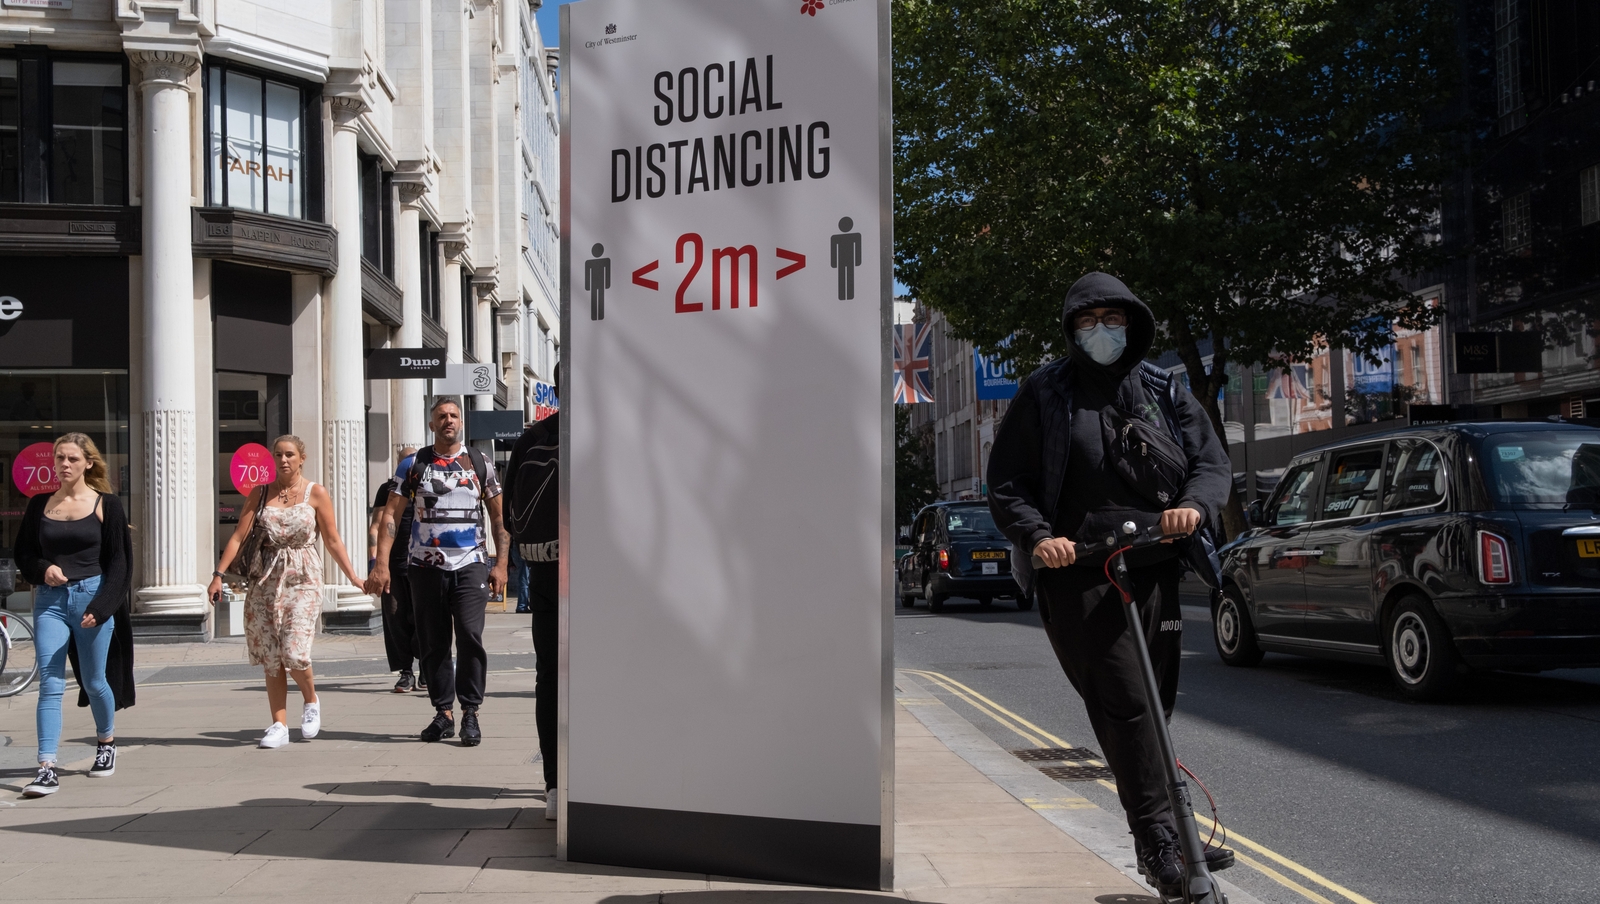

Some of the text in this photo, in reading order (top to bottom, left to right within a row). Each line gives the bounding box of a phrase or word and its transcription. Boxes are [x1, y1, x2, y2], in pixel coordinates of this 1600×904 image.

[585, 41, 596, 49] City
[604, 34, 637, 44] Westminster
[653, 54, 783, 126] SOCIAL
[219, 154, 294, 184] FARAH
[611, 120, 831, 204] DISTANCING
[241, 227, 280, 242] MAPPIN
[289, 235, 320, 250] HOUSE
[675, 232, 758, 314] 2m
[1463, 345, 1489, 356] M&S
[400, 357, 440, 367] Dune
[473, 366, 491, 389] 3
[238, 465, 269, 482] 70%
[424, 551, 445, 566] 23
[519, 540, 559, 562] NIKE
